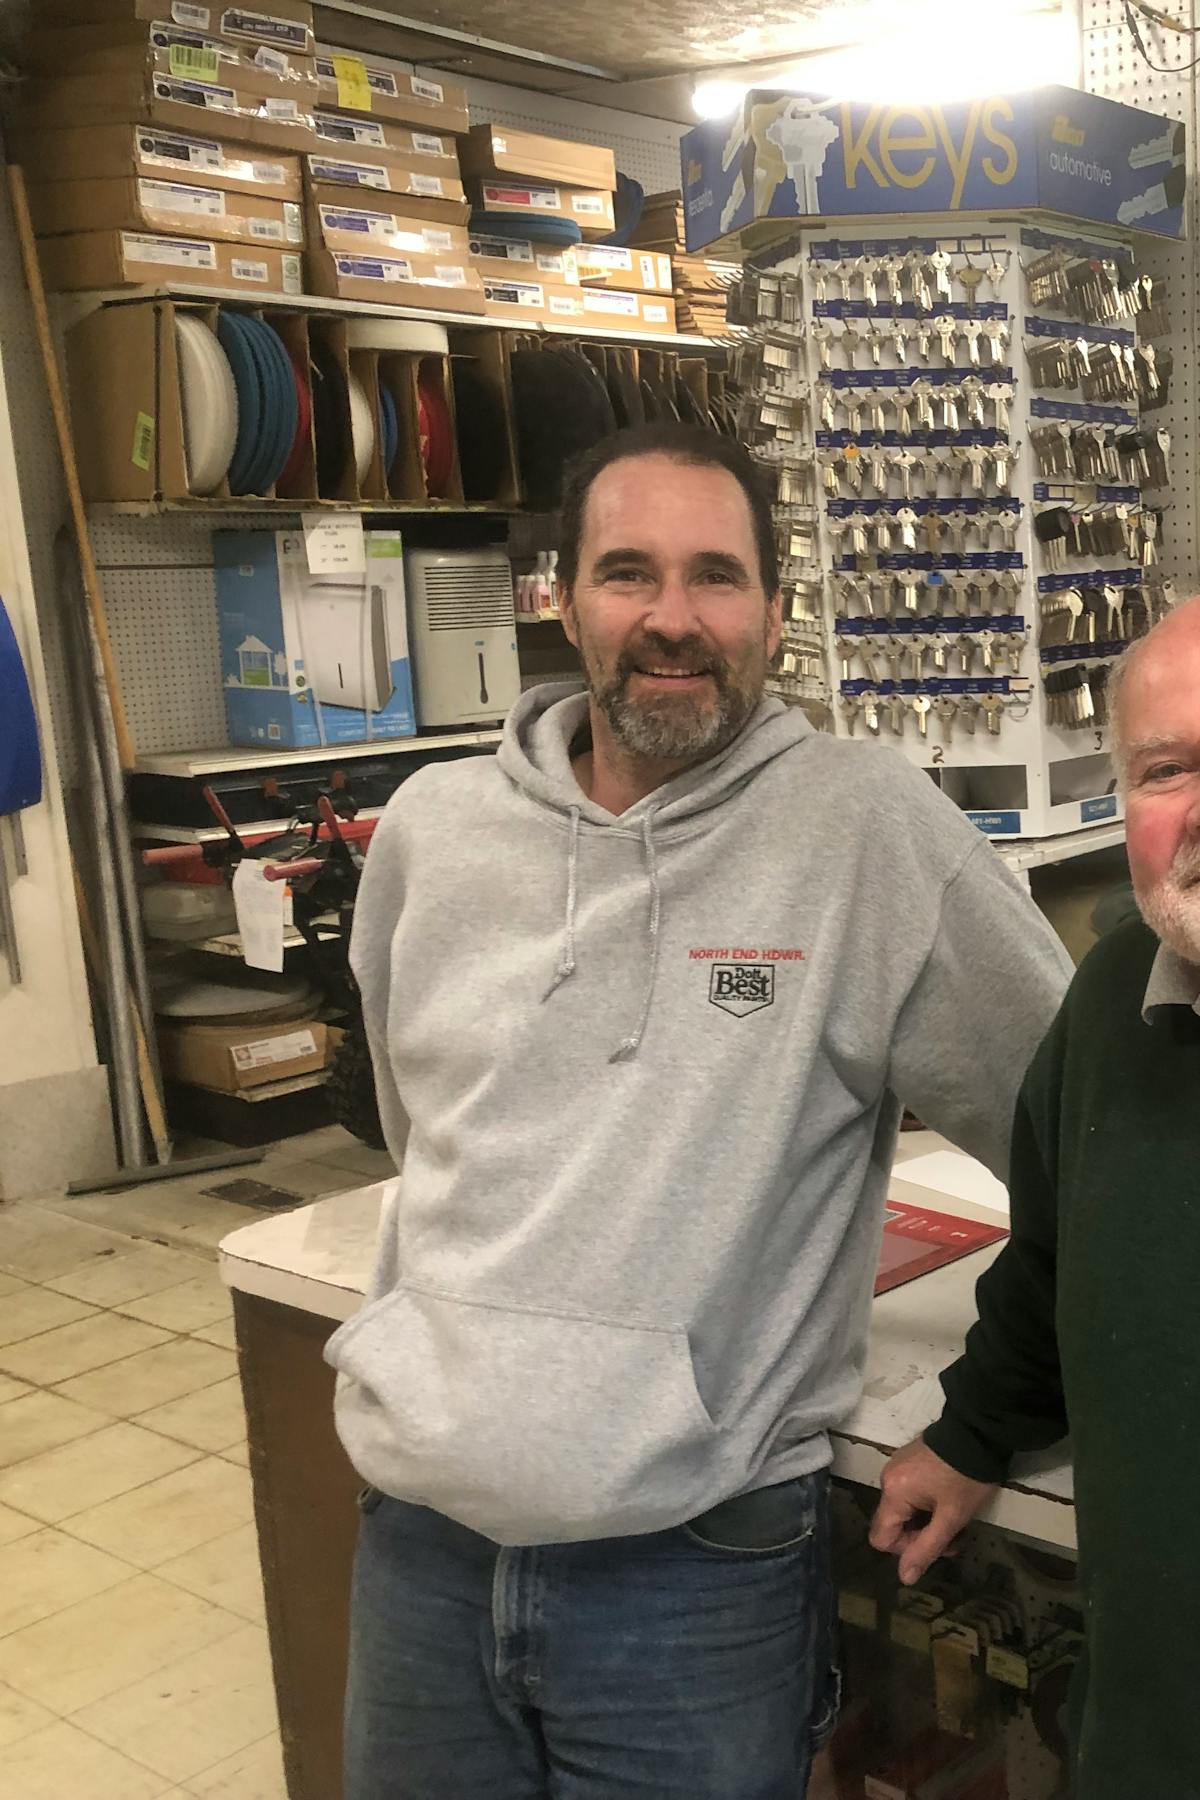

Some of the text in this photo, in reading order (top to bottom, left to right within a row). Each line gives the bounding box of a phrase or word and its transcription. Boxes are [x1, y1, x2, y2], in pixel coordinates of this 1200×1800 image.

[840, 97, 1018, 209] keys
[1049, 151, 1112, 186] automotive
[1094, 731, 1103, 750] 3
[932, 745, 944, 764] 2
[689, 949, 728, 959] NORTH
[732, 949, 758, 959] END
[715, 971, 770, 996] Best
